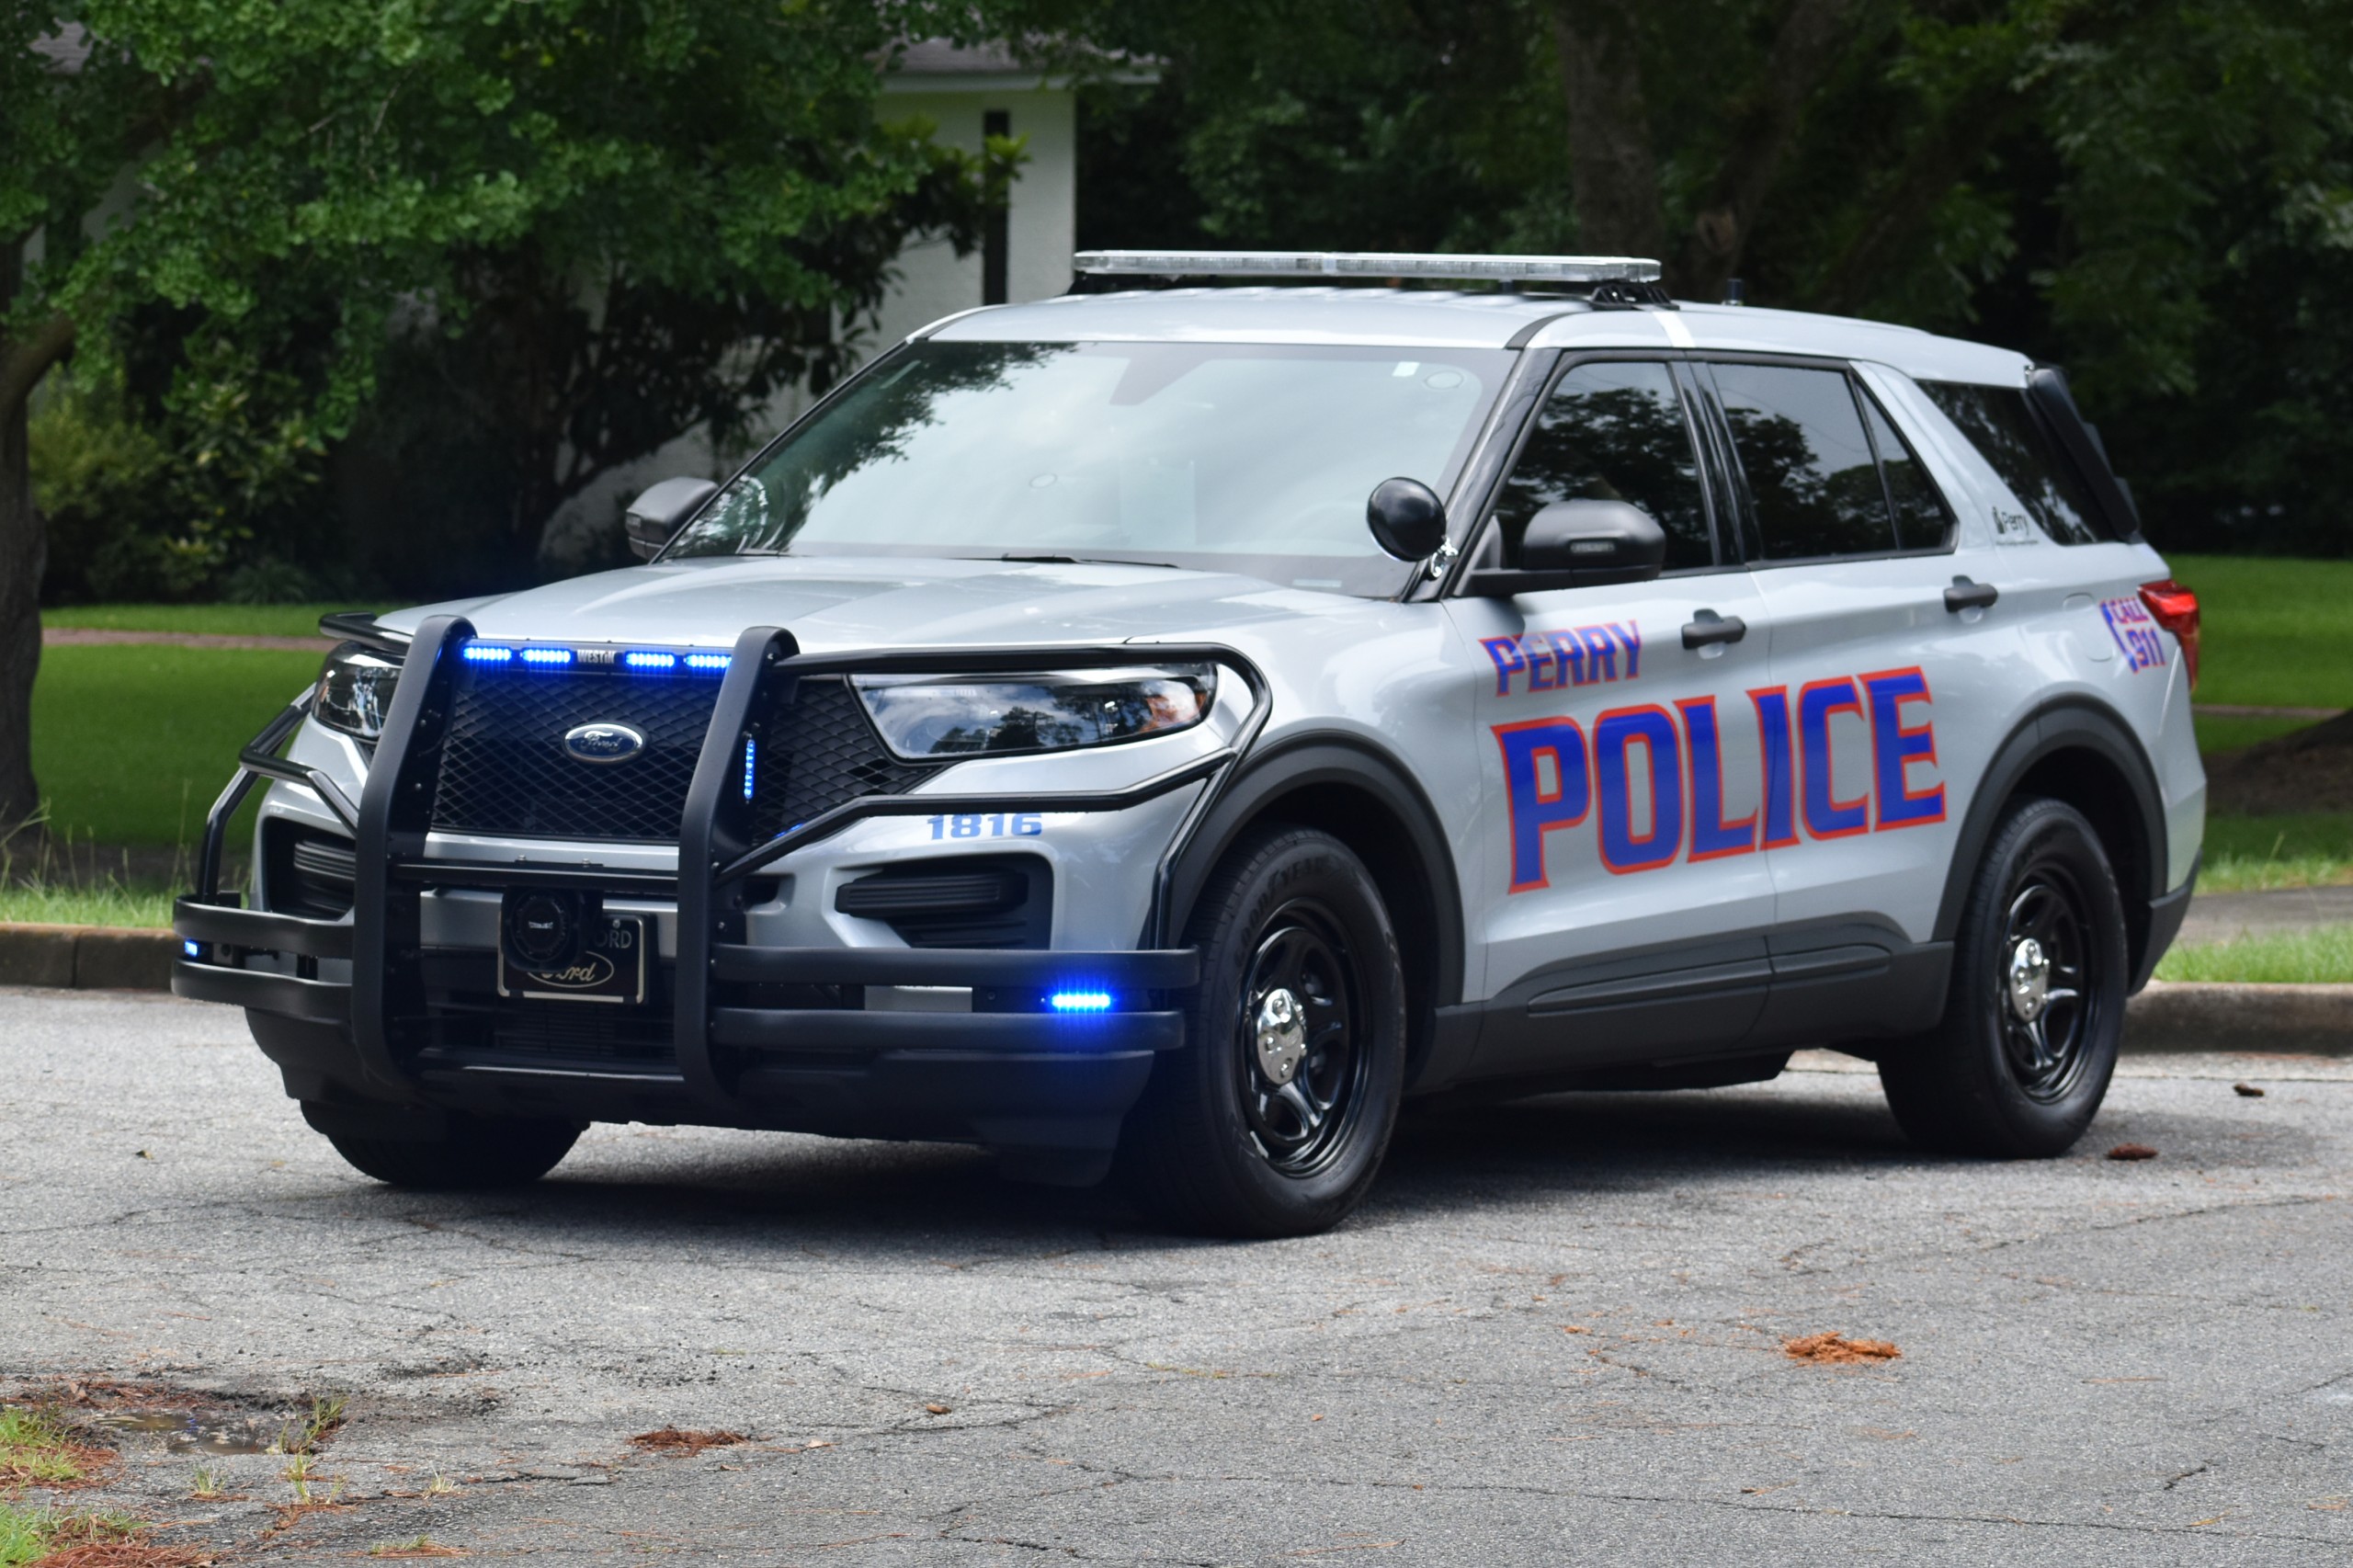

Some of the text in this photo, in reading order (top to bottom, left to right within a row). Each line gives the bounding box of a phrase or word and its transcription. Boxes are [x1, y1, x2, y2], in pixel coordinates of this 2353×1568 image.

[1478, 619, 1643, 697] PERRY
[2125, 629, 2166, 667] 911
[1490, 665, 1947, 895] POLICE
[926, 812, 1042, 840] 1816
[594, 928, 632, 949] ORD
[540, 962, 597, 982] ord
